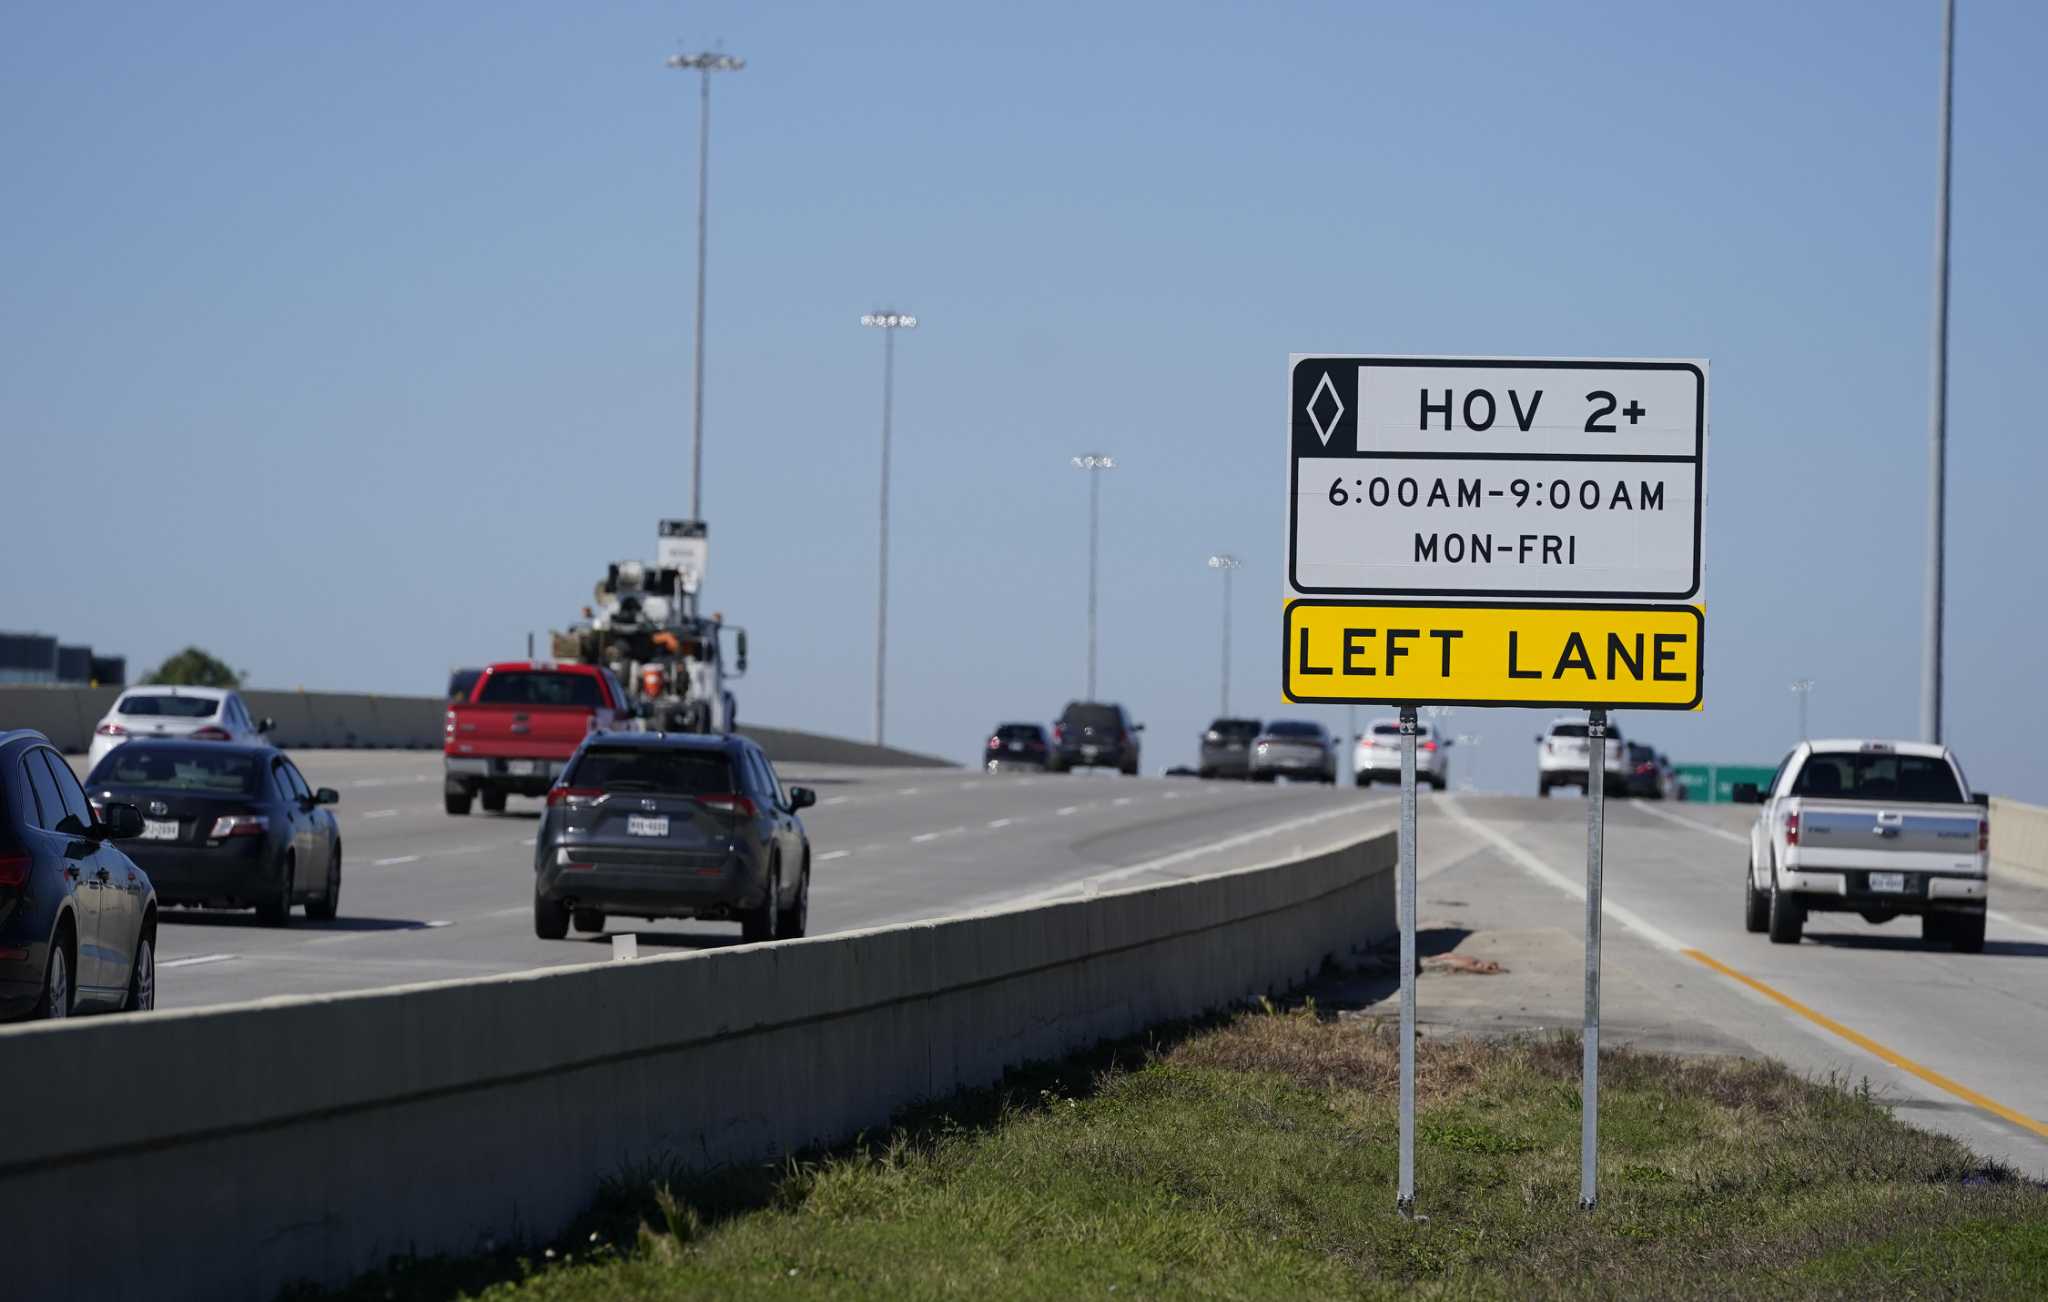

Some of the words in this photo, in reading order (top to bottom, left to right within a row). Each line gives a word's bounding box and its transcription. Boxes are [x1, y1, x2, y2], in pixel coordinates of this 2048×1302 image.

[1419, 388, 1543, 432] HOV
[1584, 390, 1646, 433] 2+
[1328, 477, 1664, 510] 6:00AM-9:00AM
[1414, 532, 1575, 564] MON-FRI
[1299, 627, 1463, 677] LEFT
[1508, 630, 1687, 682] LANE
